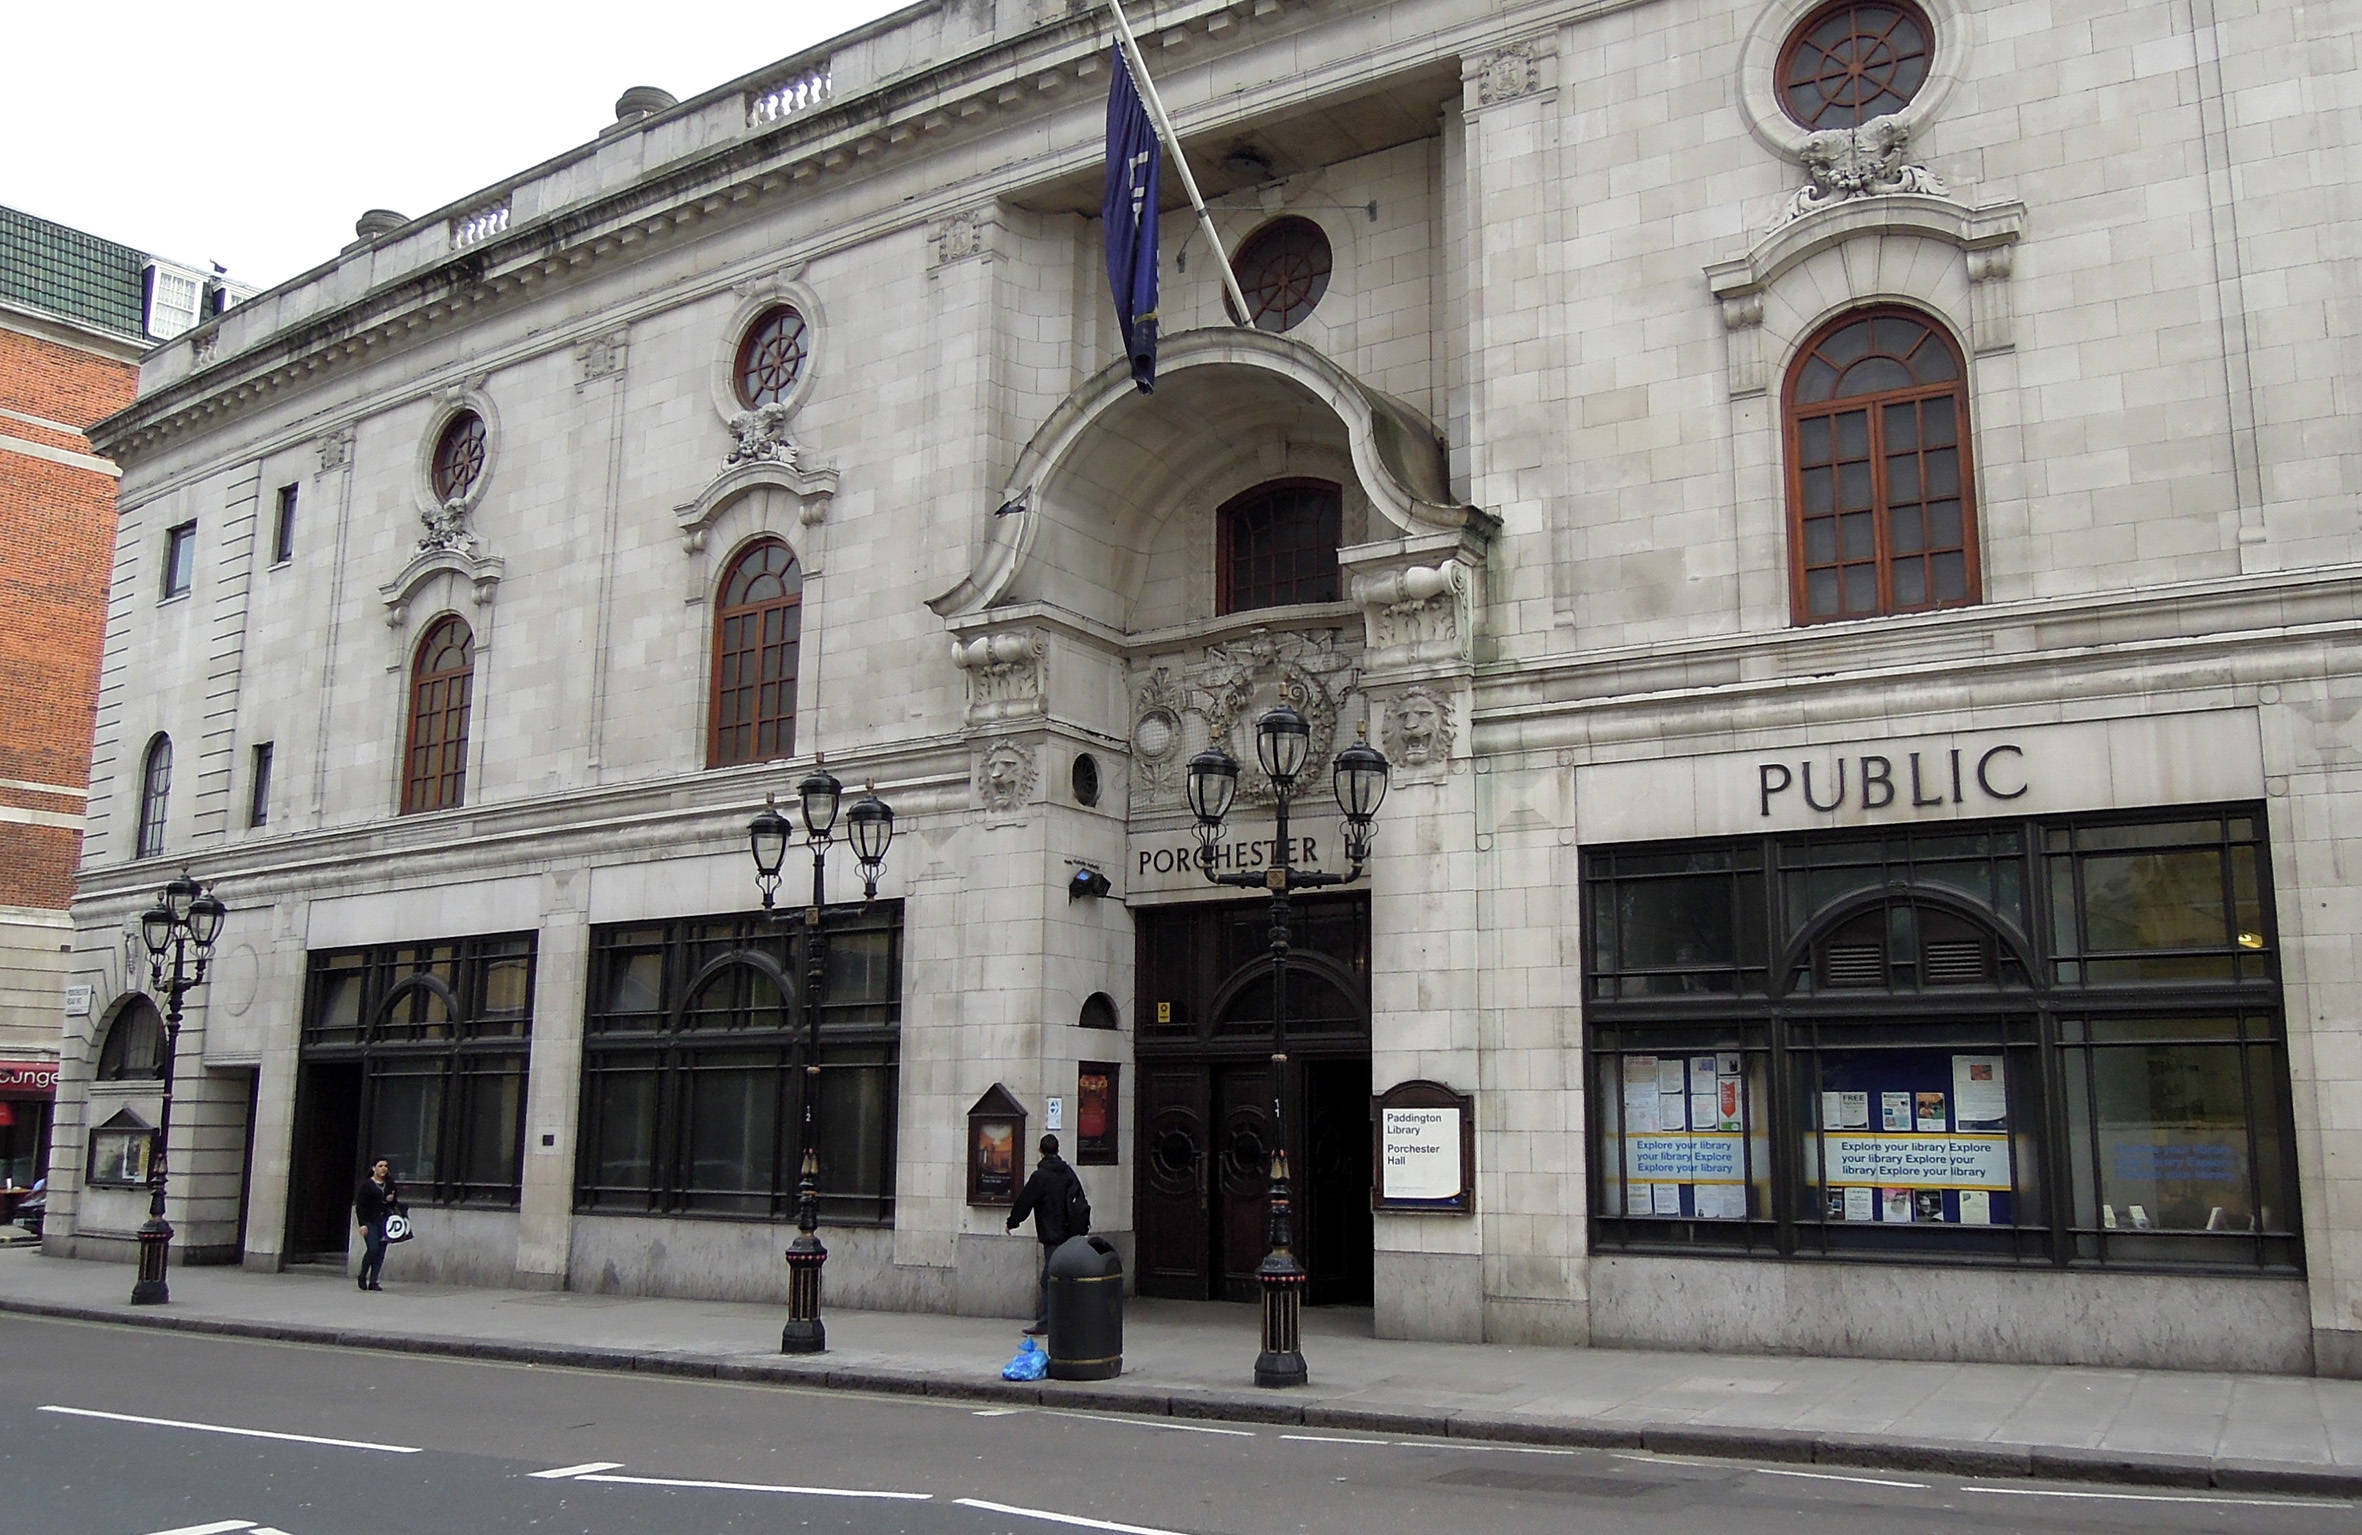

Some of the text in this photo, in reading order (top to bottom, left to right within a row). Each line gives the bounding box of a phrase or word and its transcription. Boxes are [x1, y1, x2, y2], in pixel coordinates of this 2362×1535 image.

[1759, 745, 2028, 816] PUBLIC
[1139, 837, 1318, 875] PORCHESTER
[1387, 1113, 1442, 1124] Paddington
[1387, 1126, 1420, 1136] Library
[1387, 1144, 1440, 1153] Porchester
[1636, 1140, 1731, 1151] Explore your library
[1841, 1142, 1991, 1153] Explore your library Explore
[1387, 1156, 1406, 1165] Hall
[1636, 1151, 1732, 1162] your library Explore
[1841, 1154, 1975, 1165] your library Explore your
[1637, 1163, 1733, 1174] Explore your library
[1842, 1166, 1986, 1178] library Explore your library
